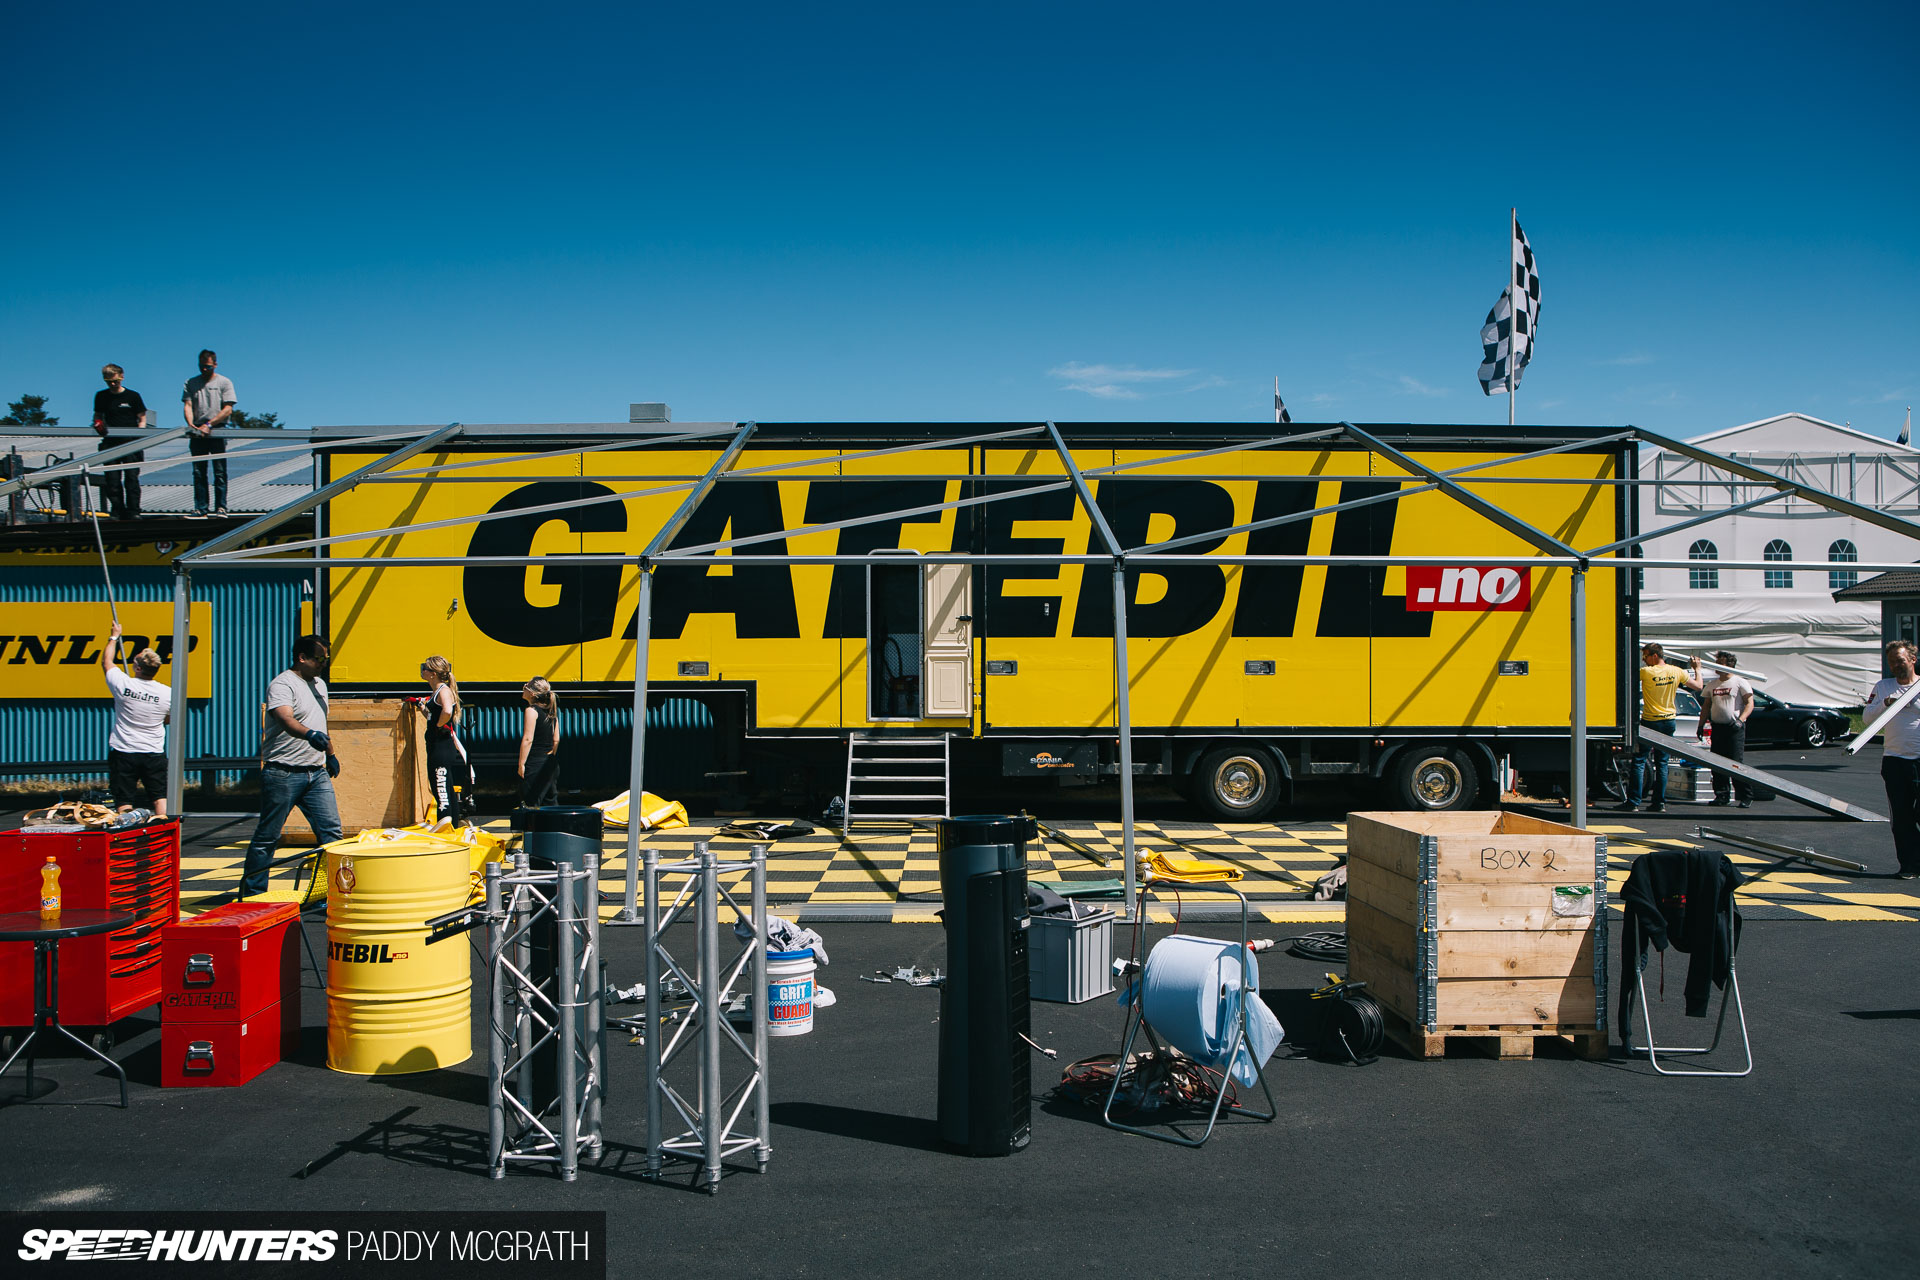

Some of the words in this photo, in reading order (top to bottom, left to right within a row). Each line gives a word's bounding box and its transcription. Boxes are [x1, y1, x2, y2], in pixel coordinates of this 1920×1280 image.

[463, 480, 1434, 648] GATEBIL
[1416, 567, 1521, 604] .no
[435, 766, 450, 808] GATEBIL
[1481, 847, 1531, 870] BOX
[164, 992, 237, 1007] GATEBIL
[780, 985, 806, 1000] GRIT
[774, 1003, 810, 1019] GUARD
